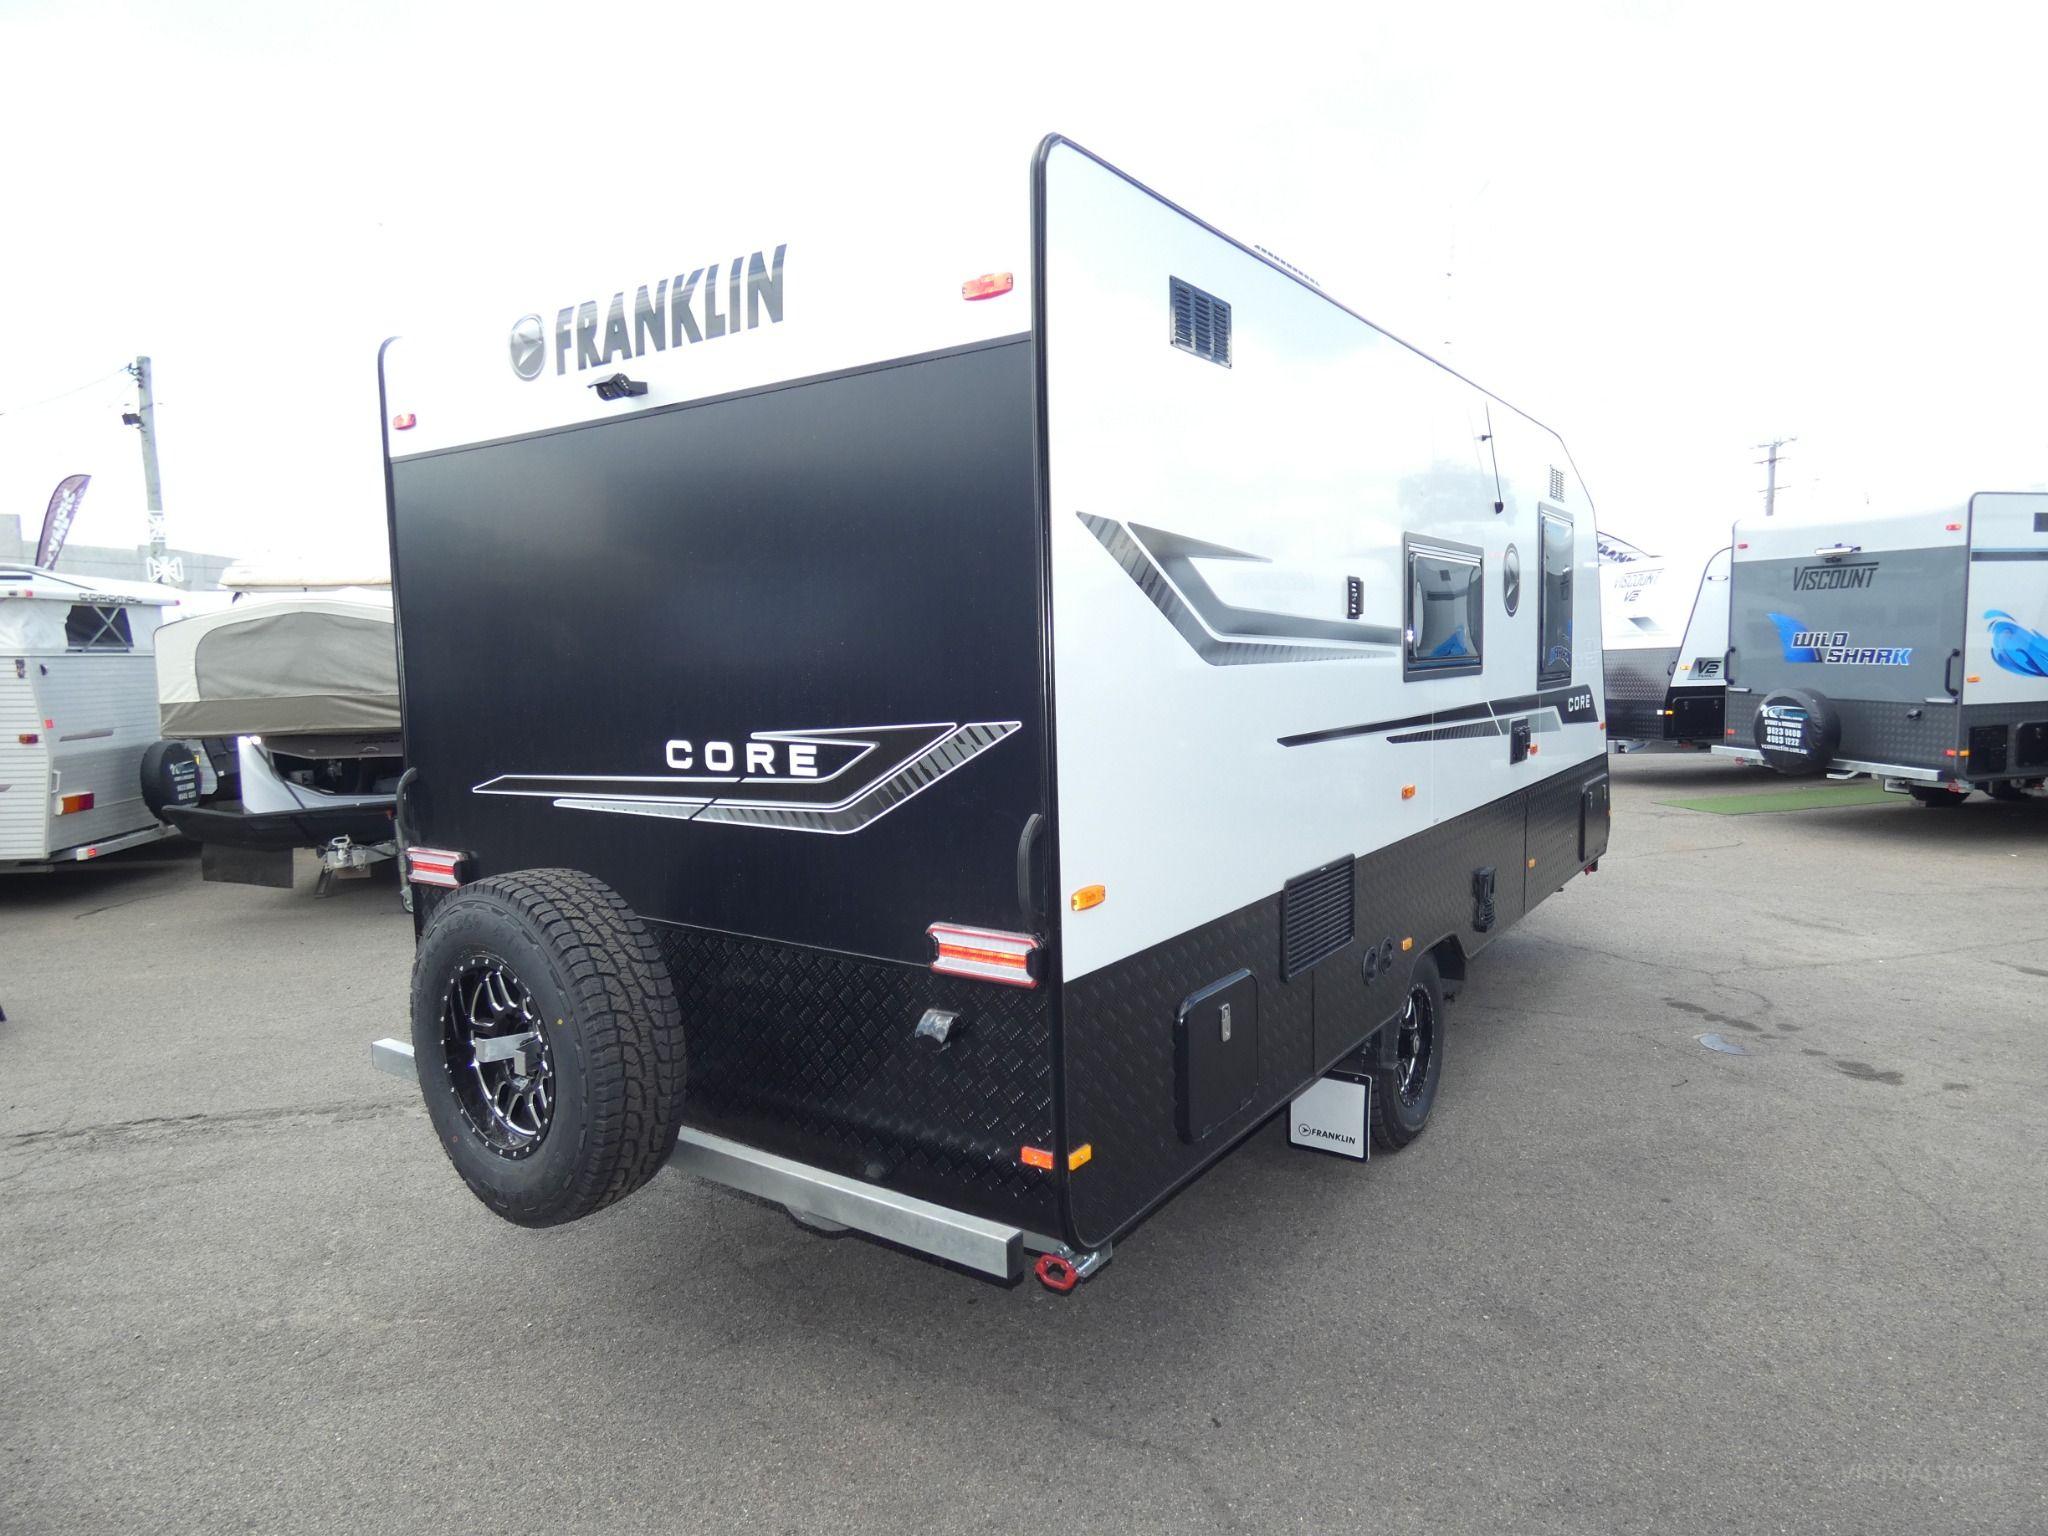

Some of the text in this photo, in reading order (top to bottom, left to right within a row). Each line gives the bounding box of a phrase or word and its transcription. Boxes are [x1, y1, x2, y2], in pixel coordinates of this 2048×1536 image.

[556, 244, 787, 376] FRANKLIN
[1793, 562, 1879, 591] VISCOUNT
[1825, 648, 1912, 665] SHARK
[1698, 660, 1722, 674] V2
[1568, 694, 1591, 712] CORE
[666, 740, 818, 776] CORE
[1311, 1128, 1356, 1145] FRANKLIN
